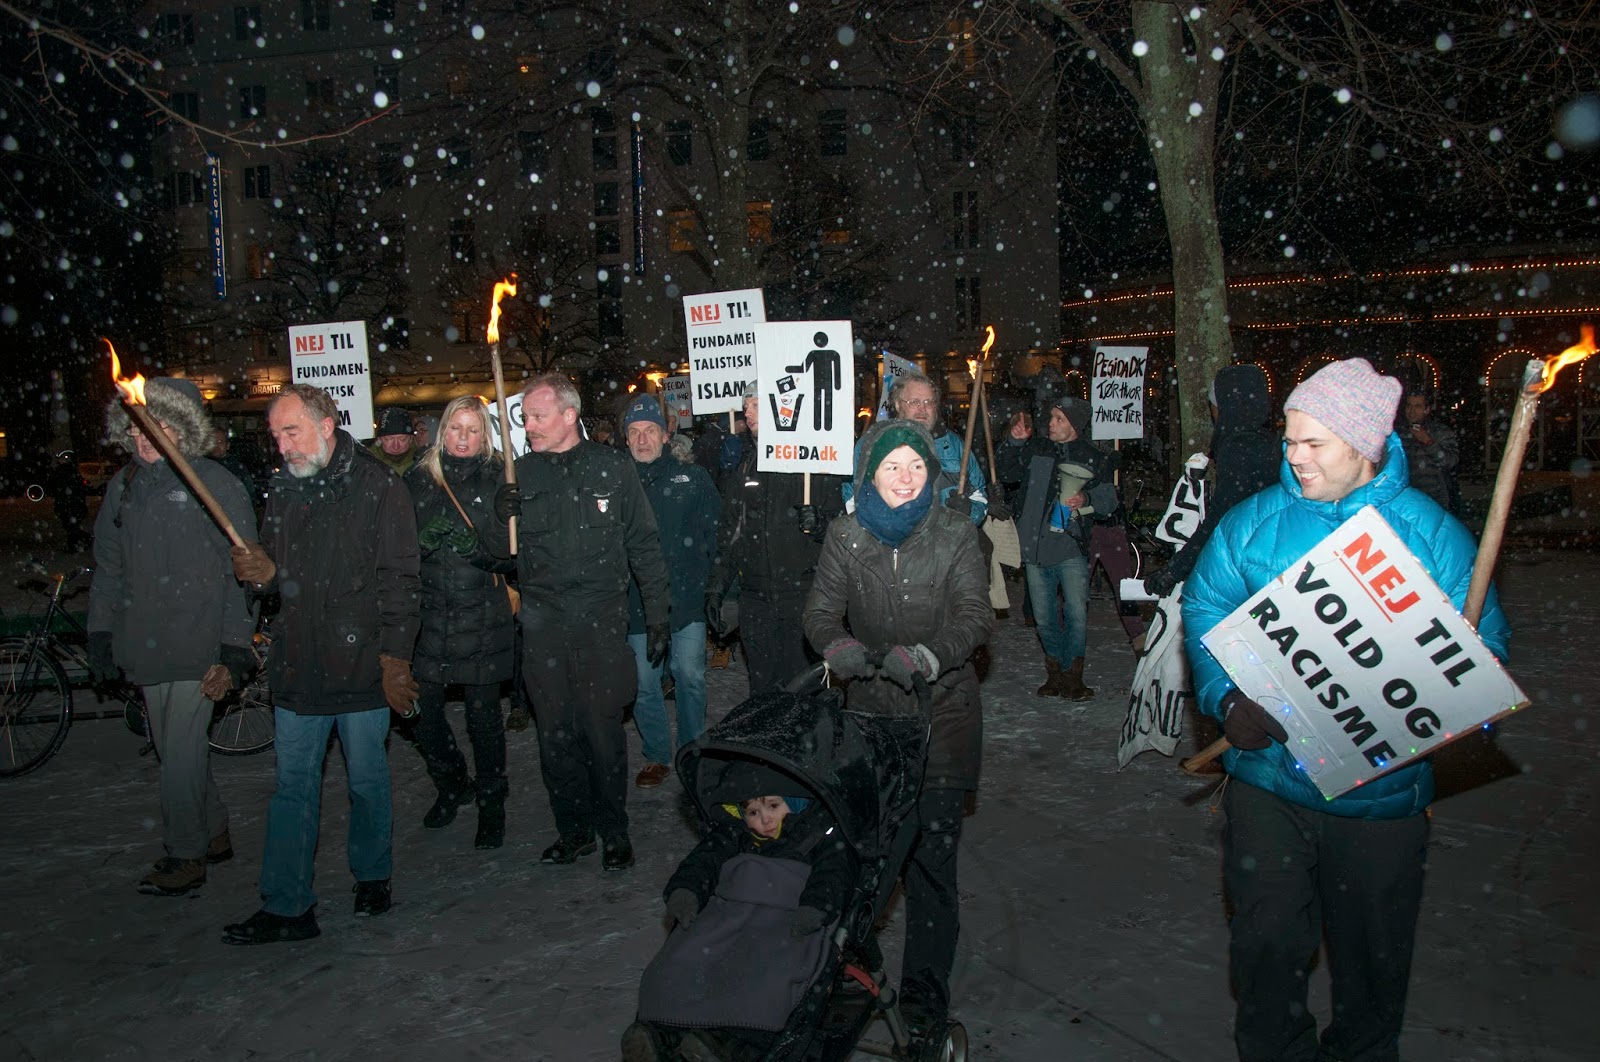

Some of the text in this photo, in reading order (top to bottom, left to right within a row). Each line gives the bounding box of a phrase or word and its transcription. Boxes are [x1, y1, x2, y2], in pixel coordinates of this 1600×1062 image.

[211, 167, 222, 277] ASCOT HOTEL
[690, 301, 751, 323] NEJ TIL
[295, 333, 354, 353] NEJ TIL
[296, 362, 368, 379] FUNDAMEN-
[694, 354, 752, 371] TALISTISK
[698, 380, 747, 400] ISLAM
[1343, 532, 1477, 688] NEJ TIL
[1294, 561, 1442, 739] VOLD OG
[1248, 597, 1398, 769] RACISME
